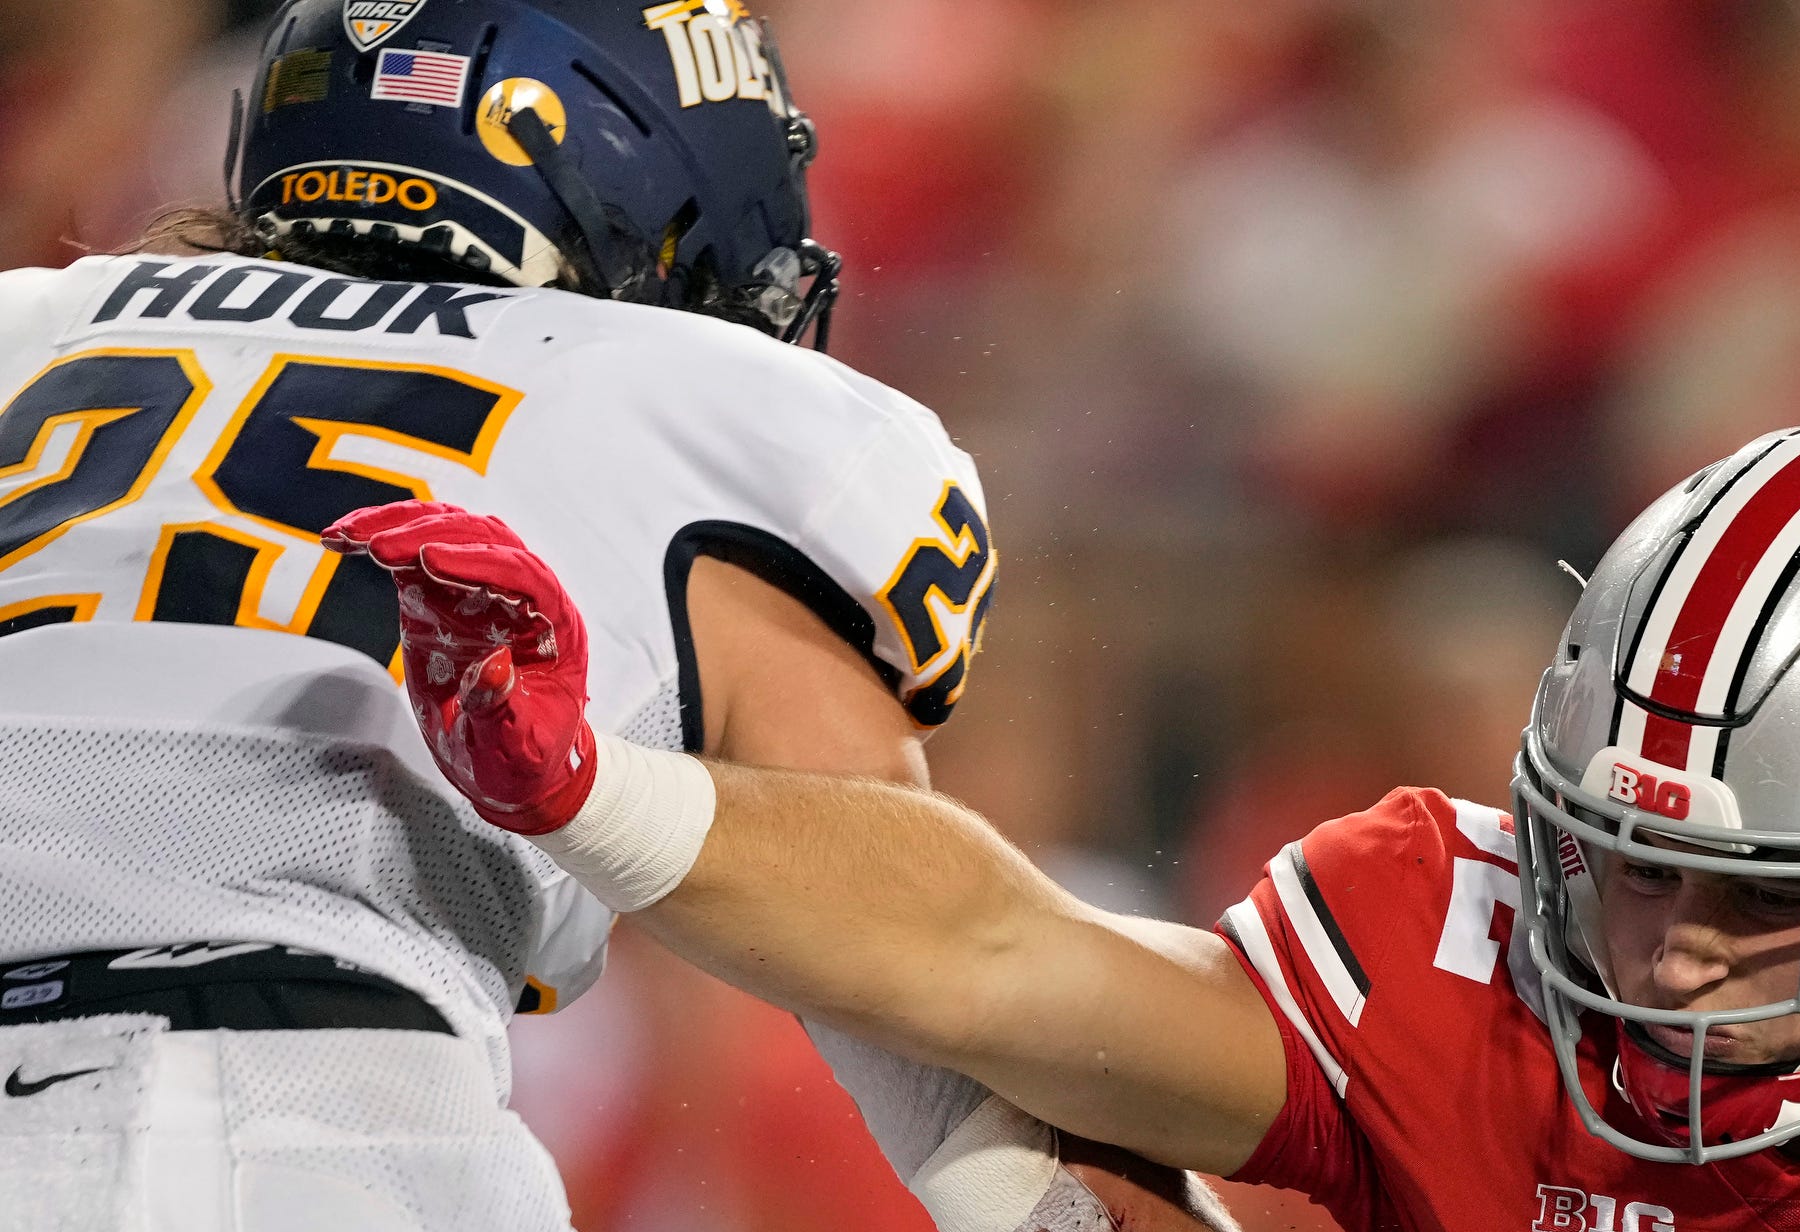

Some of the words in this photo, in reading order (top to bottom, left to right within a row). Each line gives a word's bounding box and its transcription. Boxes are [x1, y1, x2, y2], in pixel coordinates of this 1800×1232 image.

[346, 1, 415, 19] MAC
[281, 170, 438, 211] TOLEDO
[91, 261, 516, 340] HOOK
[0, 347, 525, 686] 25
